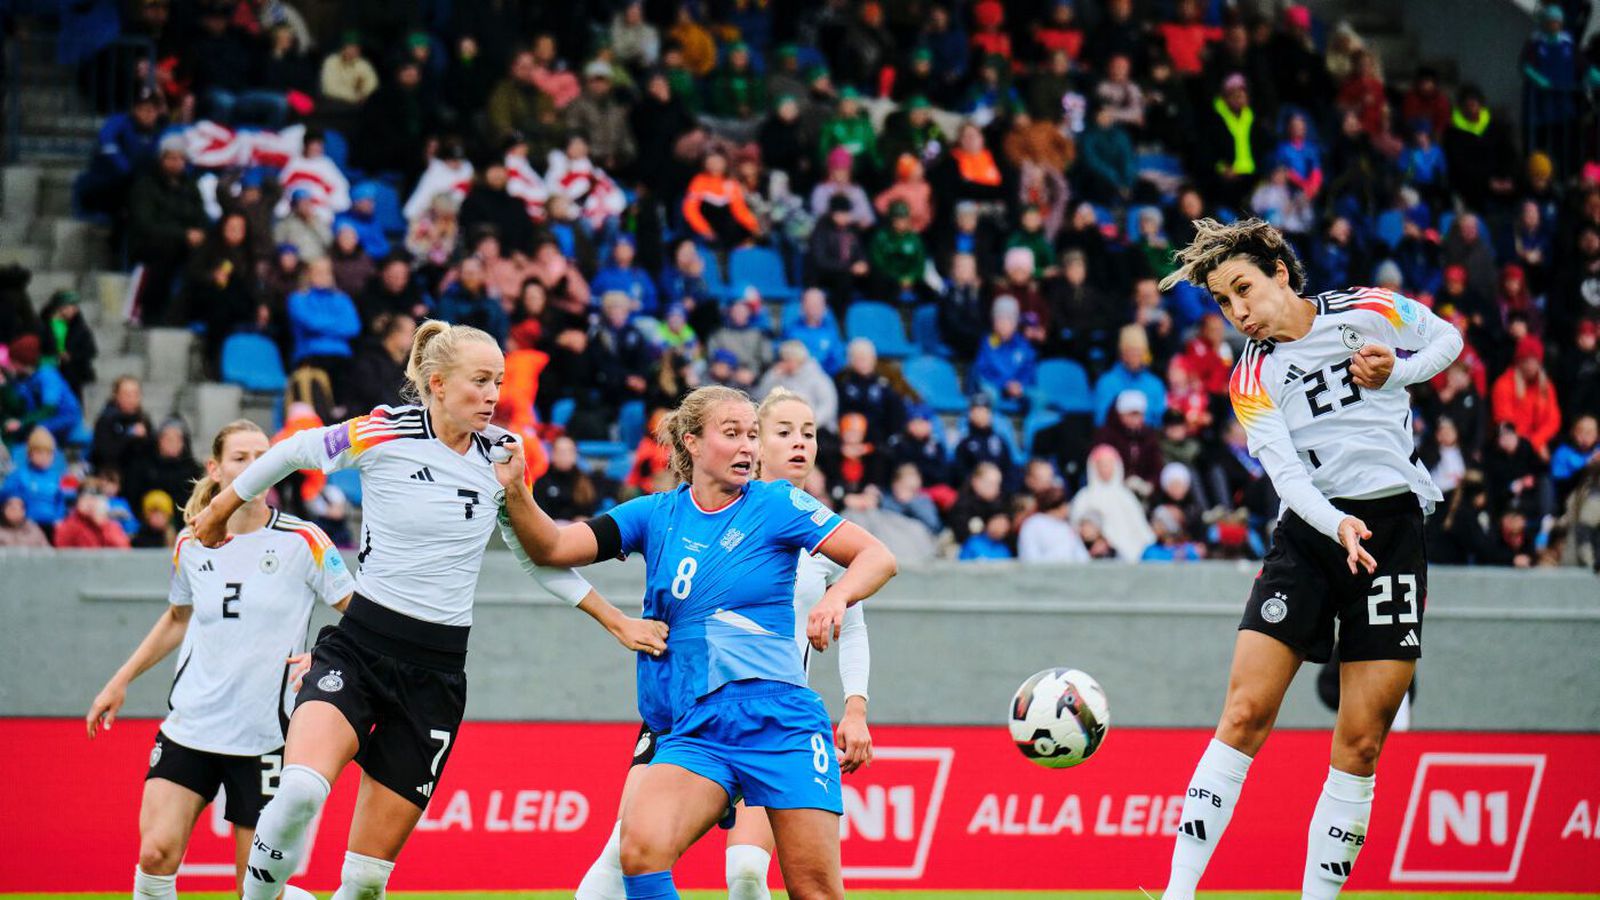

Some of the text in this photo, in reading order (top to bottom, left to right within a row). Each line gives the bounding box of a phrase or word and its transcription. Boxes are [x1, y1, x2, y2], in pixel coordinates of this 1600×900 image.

[1303, 357, 1363, 418] 23
[457, 488, 480, 520] 7
[671, 556, 698, 600] 8
[222, 582, 242, 619] 2
[1367, 574, 1418, 625] 23
[430, 729, 451, 777] 7
[810, 733, 829, 774] 8
[260, 754, 282, 796] 2
[415, 790, 590, 832] LA LEIÐ
[839, 785, 914, 841] N1
[966, 793, 1083, 835] ALLA
[1188, 787, 1222, 808] DFB
[1428, 790, 1509, 845] N1
[1328, 826, 1366, 846] DFB
[1561, 799, 1600, 840] A
